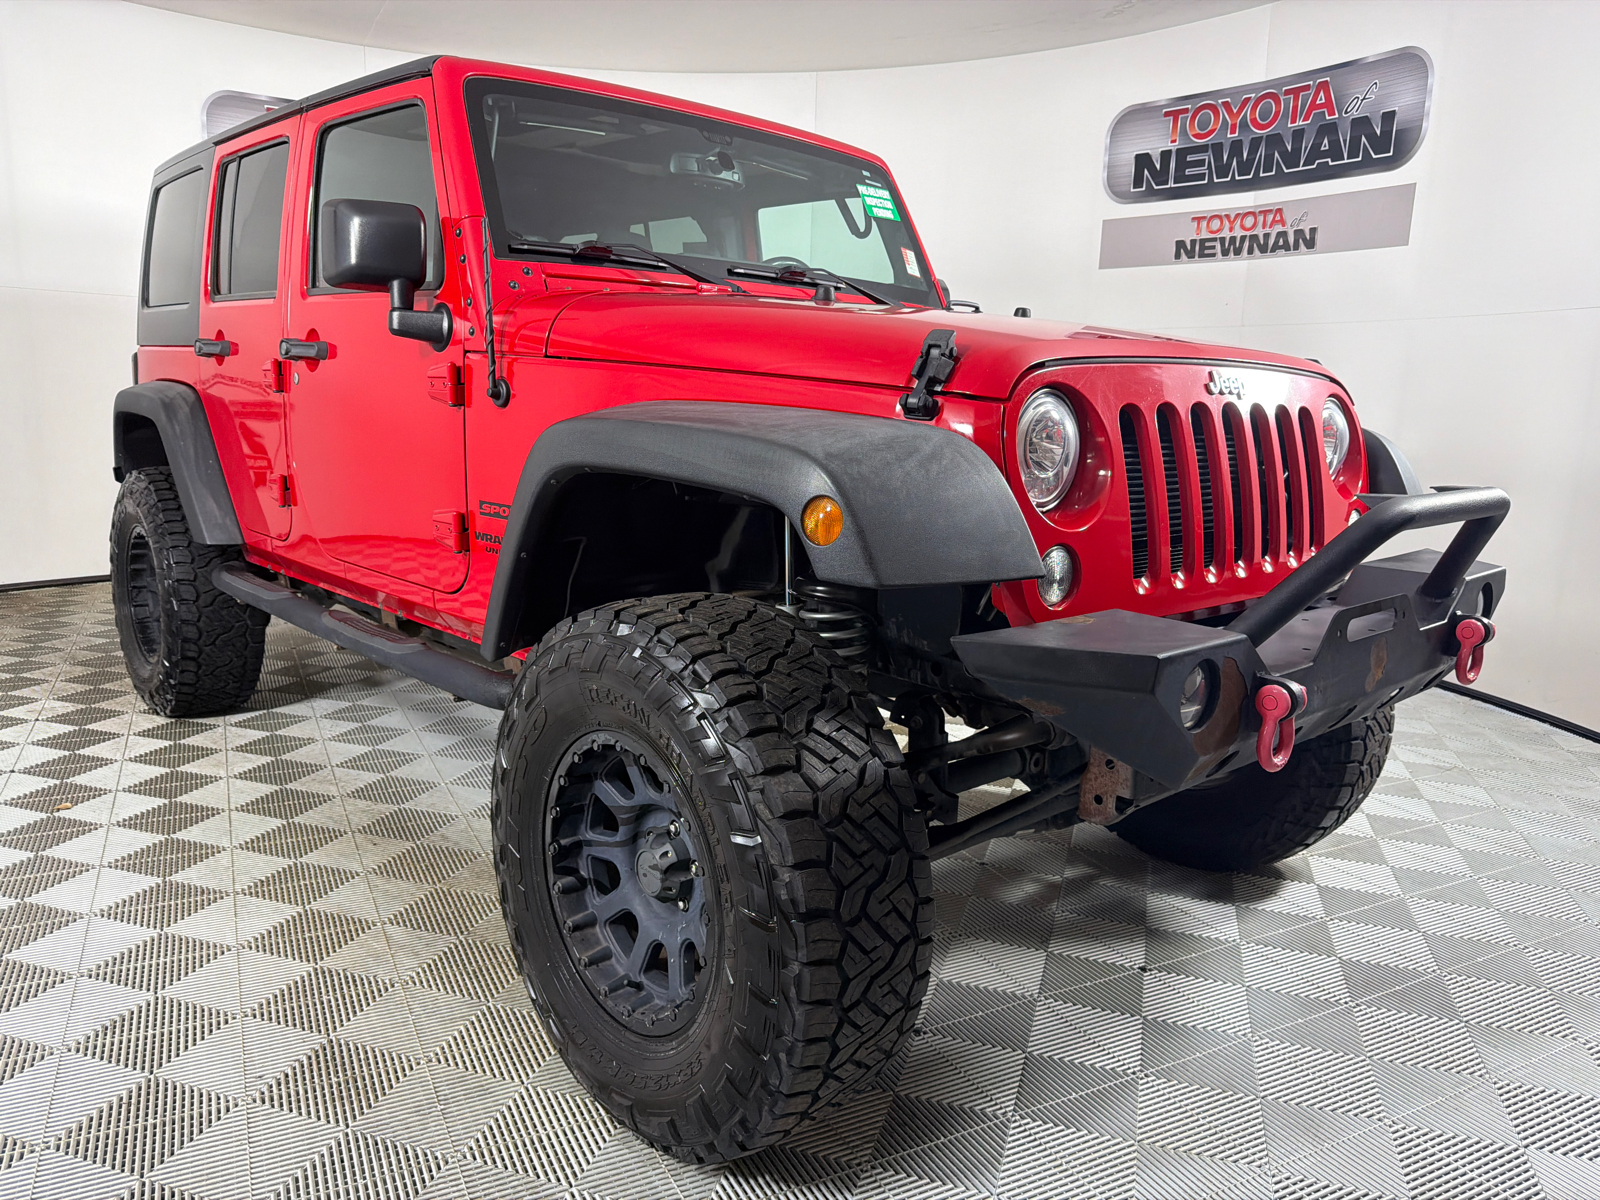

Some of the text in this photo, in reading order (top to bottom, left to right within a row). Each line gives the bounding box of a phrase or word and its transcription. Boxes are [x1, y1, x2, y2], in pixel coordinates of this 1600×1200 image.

[1162, 77, 1379, 145] TOYOTA of
[1130, 107, 1399, 192] NEWNAN
[864, 196, 894, 209] INSPECTION
[872, 207, 894, 219] PENDING
[1190, 207, 1309, 236] TOYOTA of
[1173, 226, 1318, 261] NEWNAN
[1204, 370, 1246, 400] Jeep
[480, 503, 511, 517] SPO
[474, 531, 504, 545] WRA
